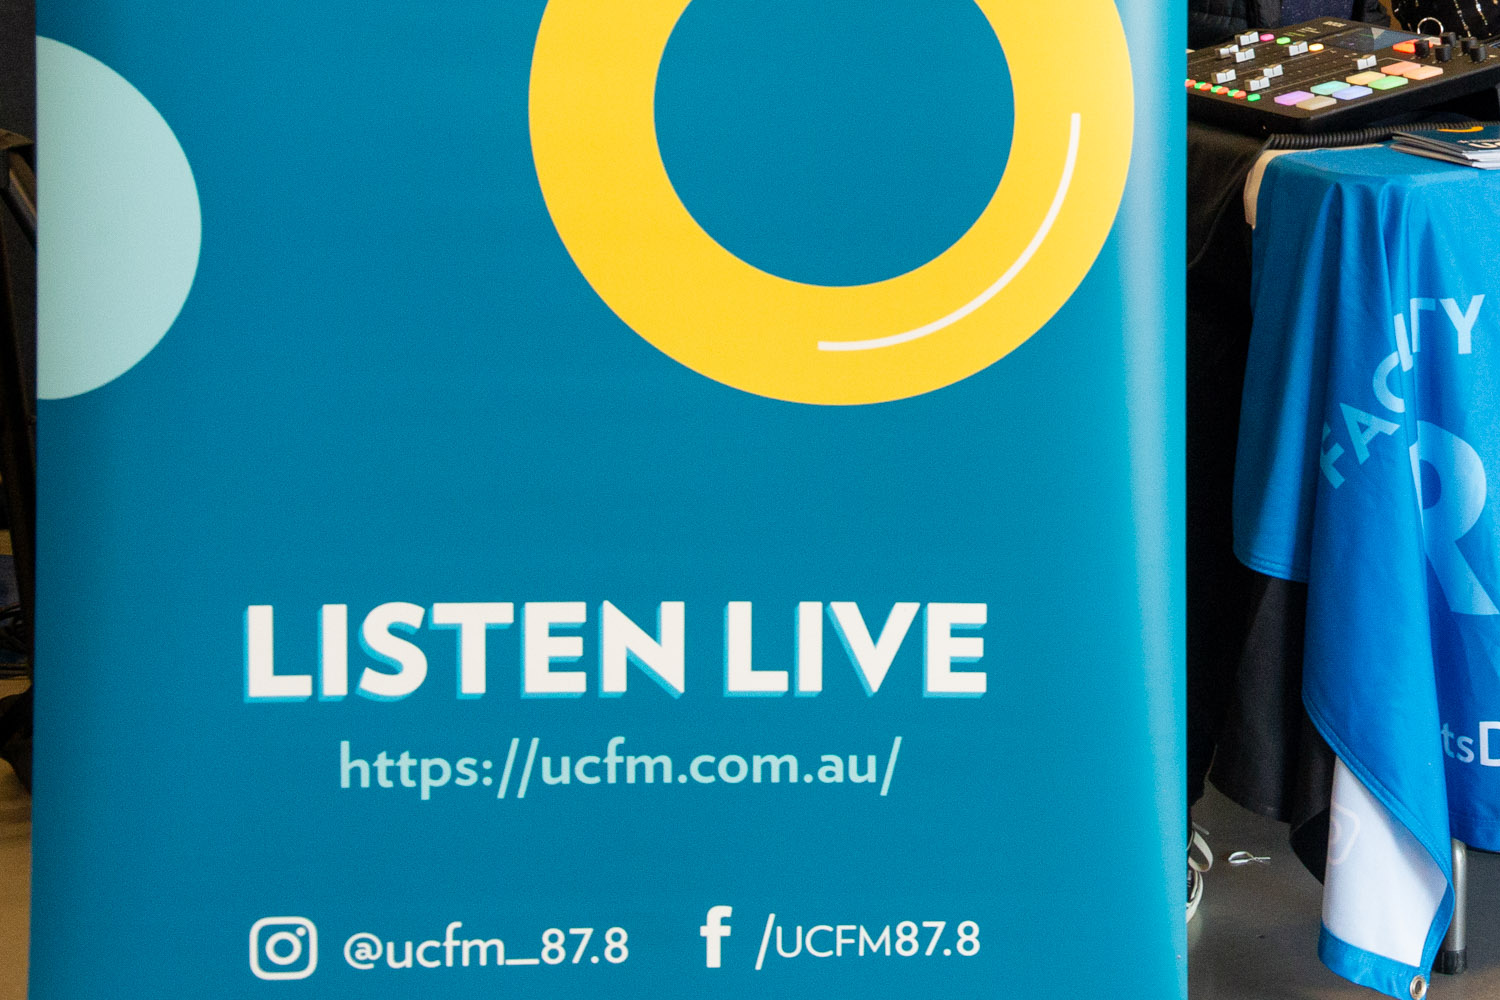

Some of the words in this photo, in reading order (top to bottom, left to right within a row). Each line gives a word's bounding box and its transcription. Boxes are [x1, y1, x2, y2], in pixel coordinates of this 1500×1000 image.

[243, 600, 685, 704] LISTEN
[723, 600, 988, 699] LIVE
[339, 735, 902, 801] https://ucfm.com.au/
[343, 921, 631, 971] @ucfm_87.8
[755, 911, 982, 971] /UCFM87.8
